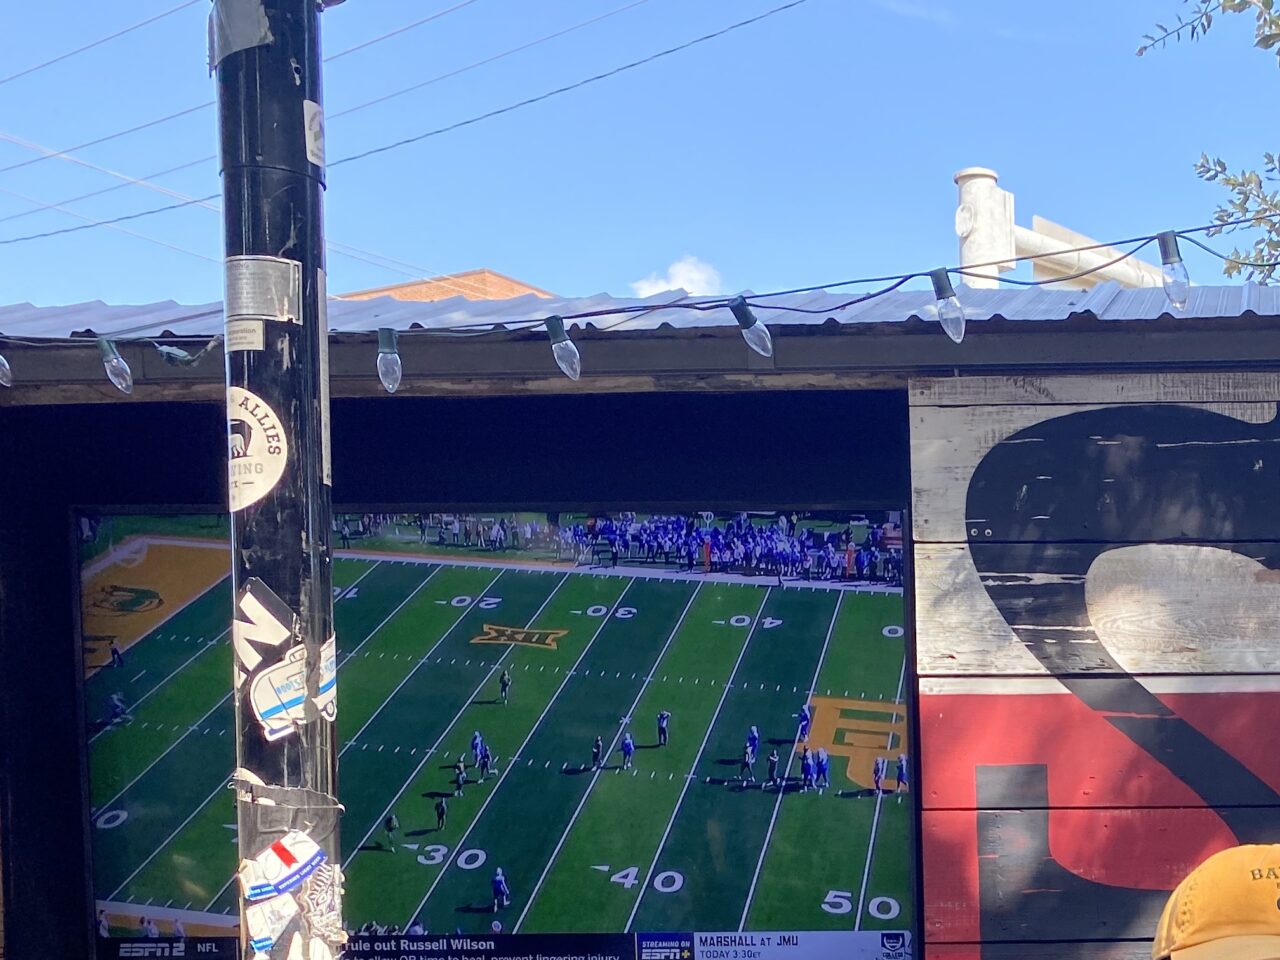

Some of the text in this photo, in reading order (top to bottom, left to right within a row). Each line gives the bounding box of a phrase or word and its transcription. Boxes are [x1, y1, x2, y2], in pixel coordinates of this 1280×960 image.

[238, 396, 282, 456] ALLIES
[417, 844, 487, 870] 30
[610, 866, 684, 892] 40
[820, 890, 900, 920] 50
[197, 943, 219, 953] NFL
[345, 938, 495, 951] rule out Russell Wilson
[699, 935, 798, 947] MARSHALL AT JMU
[700, 950, 730, 959] TODAY
